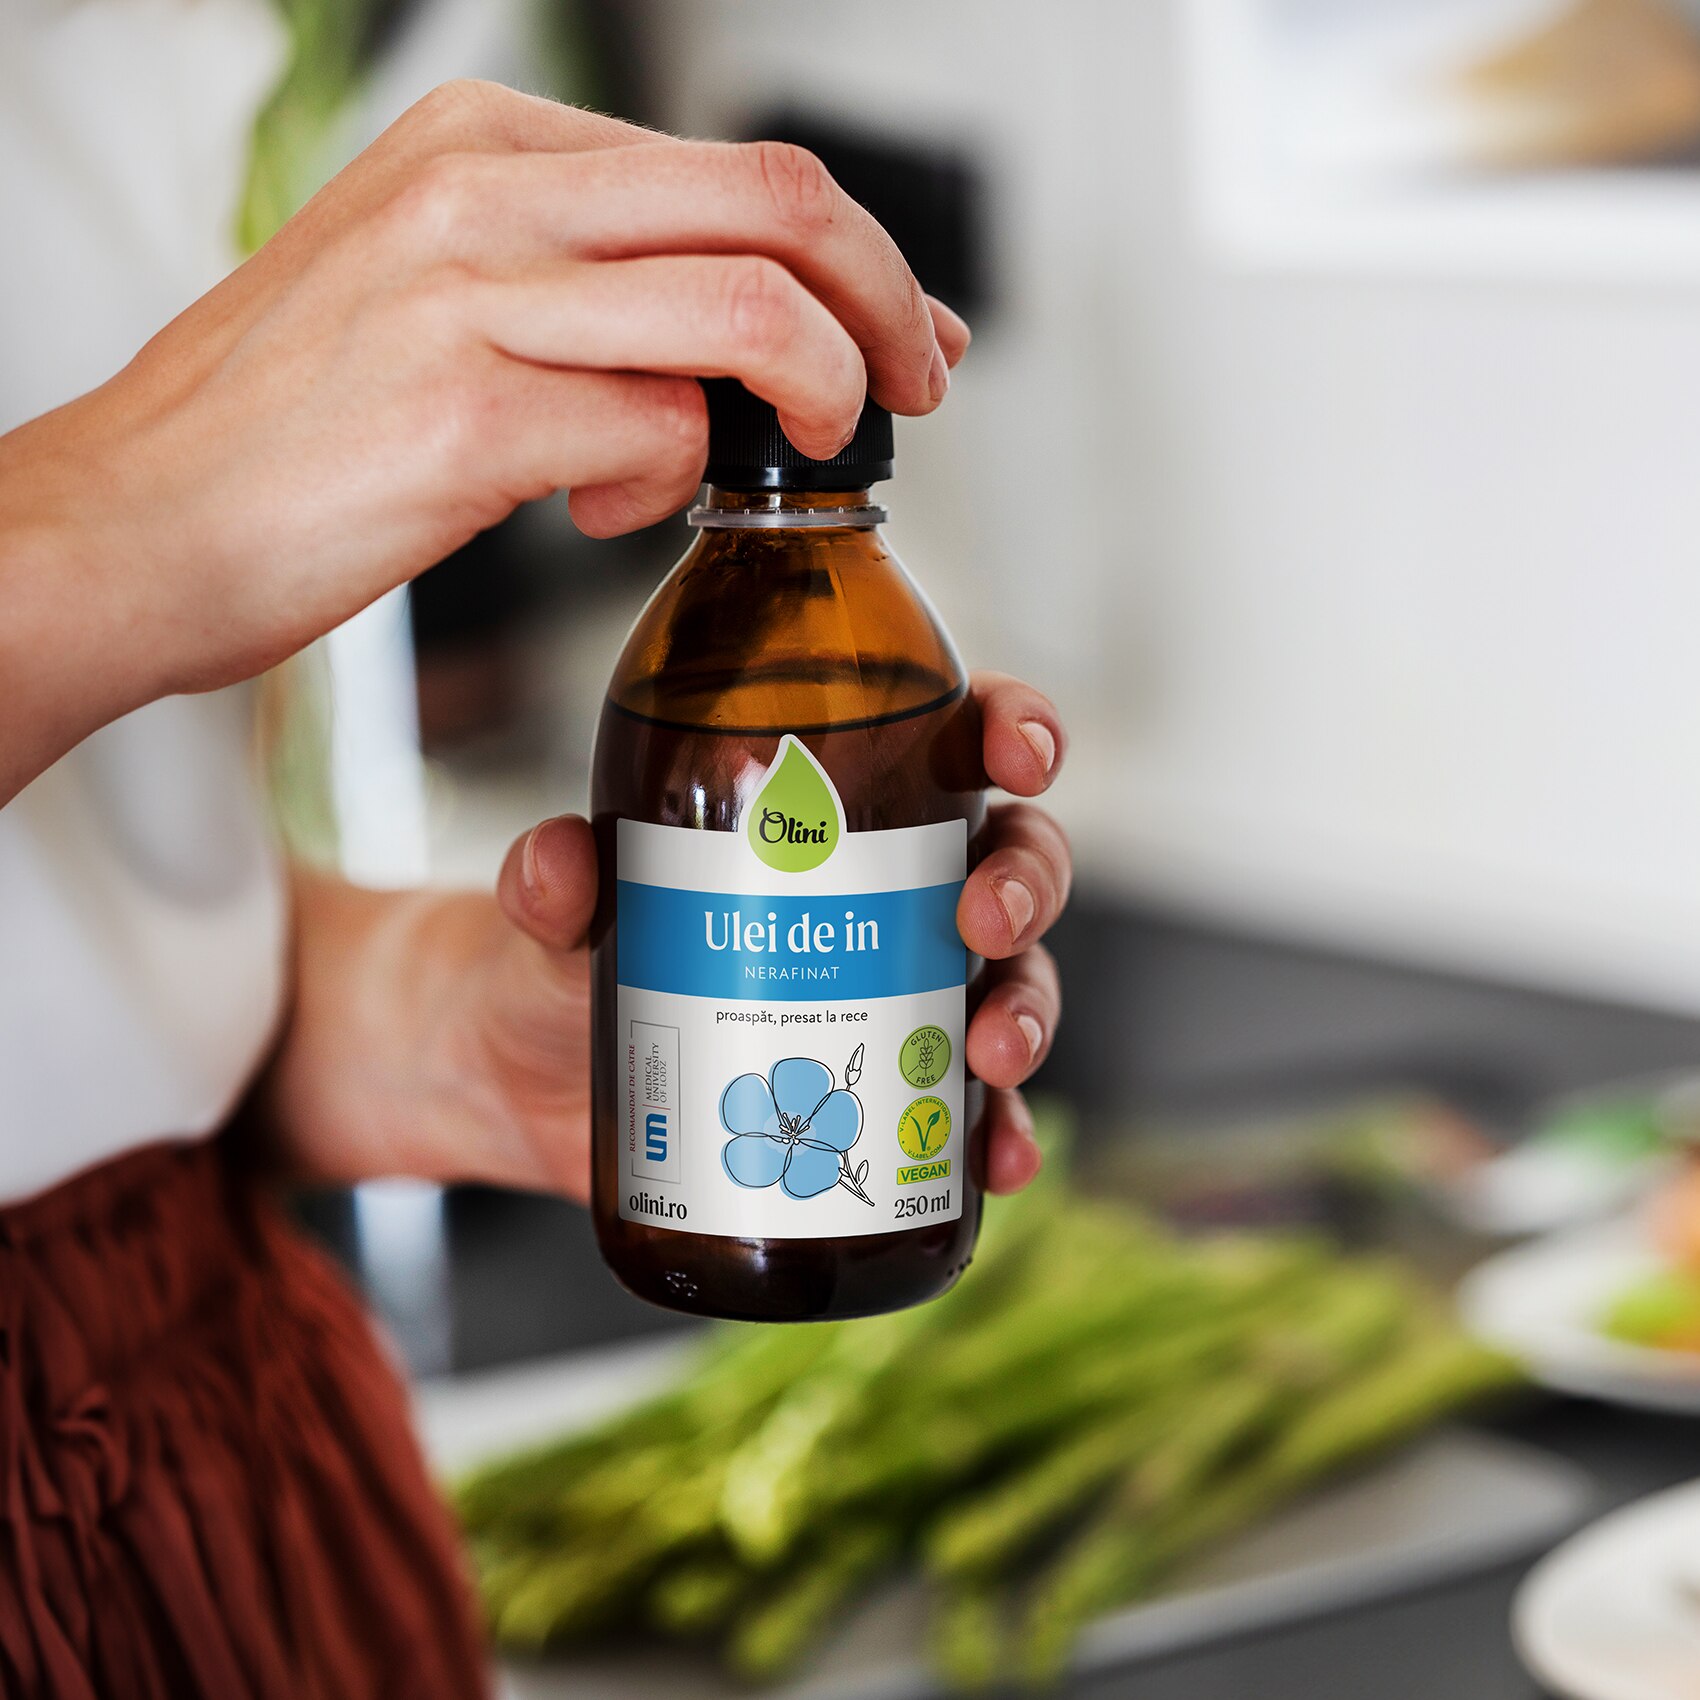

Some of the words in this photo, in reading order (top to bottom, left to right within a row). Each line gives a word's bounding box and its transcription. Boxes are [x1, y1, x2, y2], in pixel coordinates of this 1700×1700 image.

[759, 807, 829, 844] Olini
[705, 910, 777, 953] Ulei
[788, 913, 835, 953] de
[845, 911, 879, 951] in
[745, 966, 840, 980] NERAFINAT
[716, 1010, 777, 1026] proaspăt,
[781, 1012, 822, 1027] presat
[826, 1010, 837, 1023] la
[841, 1011, 869, 1022] rece
[910, 1030, 943, 1046] GLUTEN
[629, 1076, 636, 1087] DE
[652, 1043, 660, 1102] UNIVERSITY
[659, 1060, 667, 1087] LODZ
[916, 1074, 936, 1084] FREE
[659, 1089, 667, 1103] OF
[900, 1163, 948, 1182] VEGAN
[629, 1191, 688, 1220] olini.ro
[894, 1195, 928, 1219] 250
[931, 1189, 950, 1213] ml
